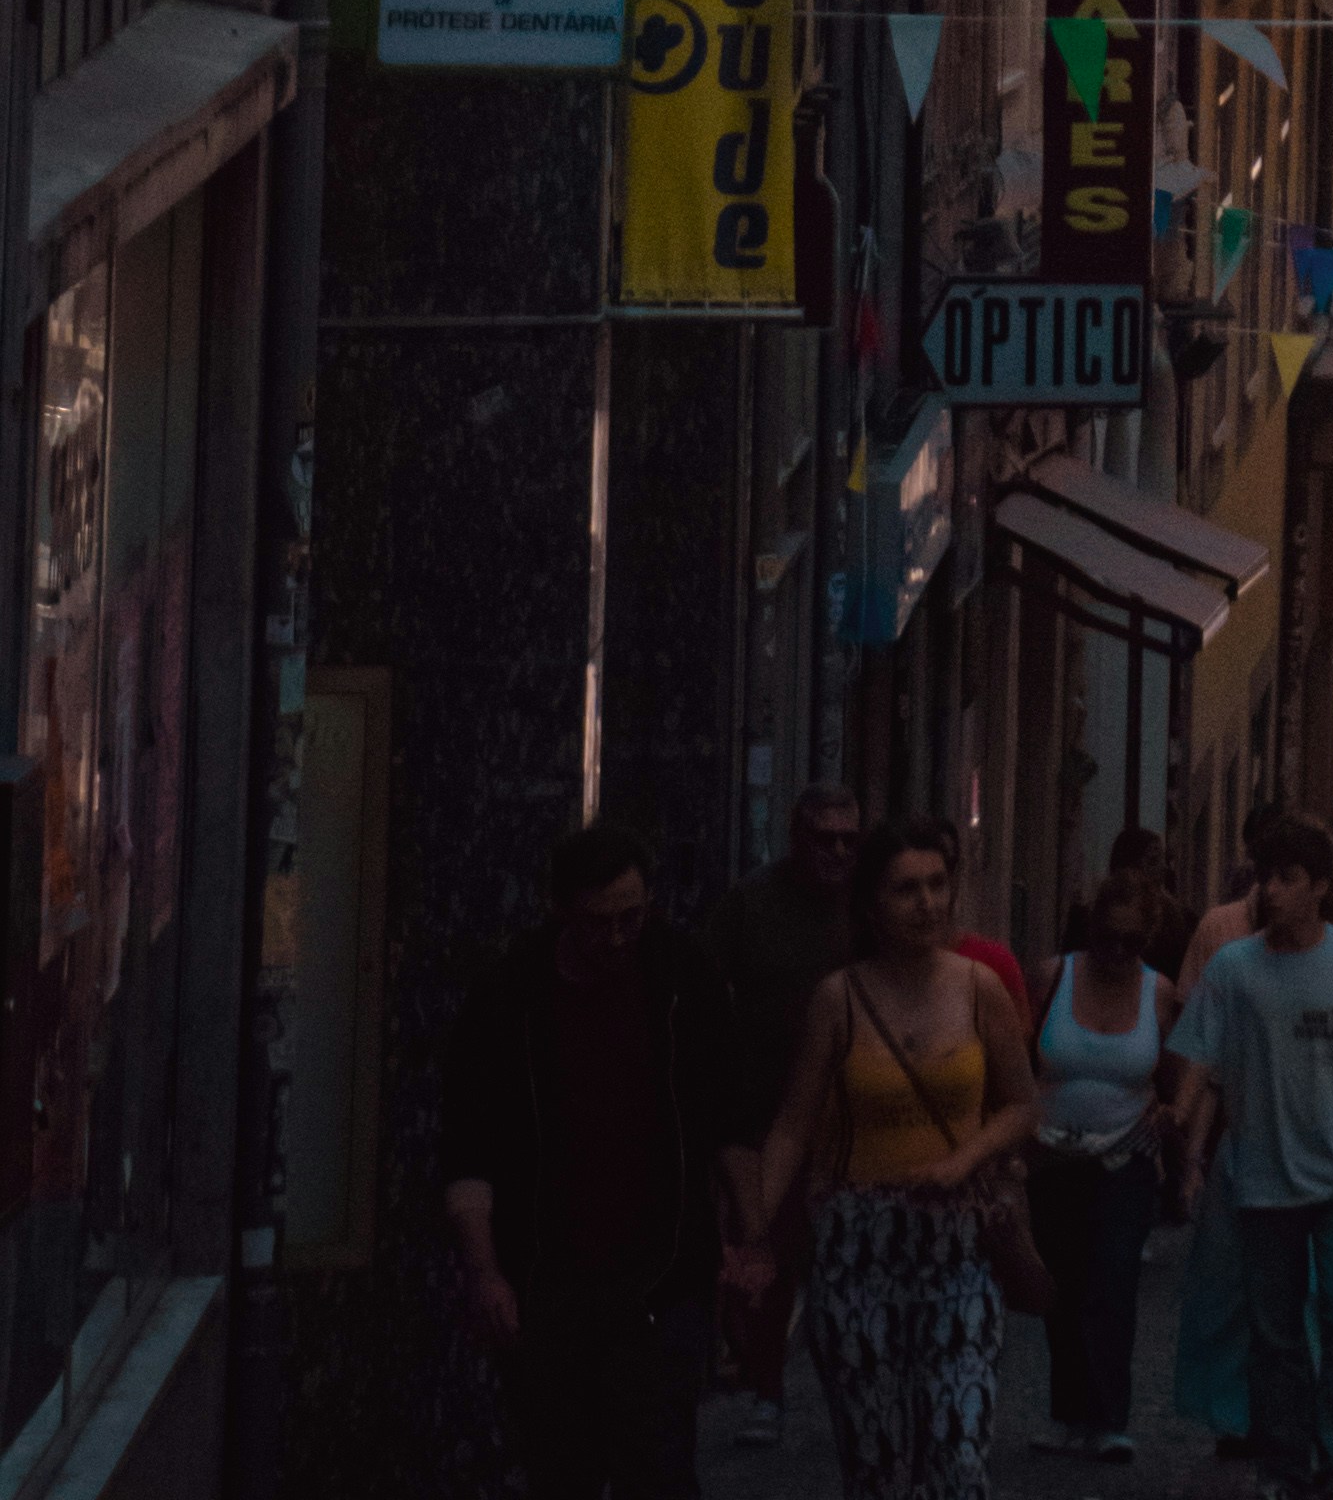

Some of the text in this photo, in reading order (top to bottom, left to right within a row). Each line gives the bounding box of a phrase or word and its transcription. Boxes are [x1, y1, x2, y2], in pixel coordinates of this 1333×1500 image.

[387, 6, 618, 32] PRÓTESE DENTÁRIA
[944, 286, 1140, 387] ÓPTICO
